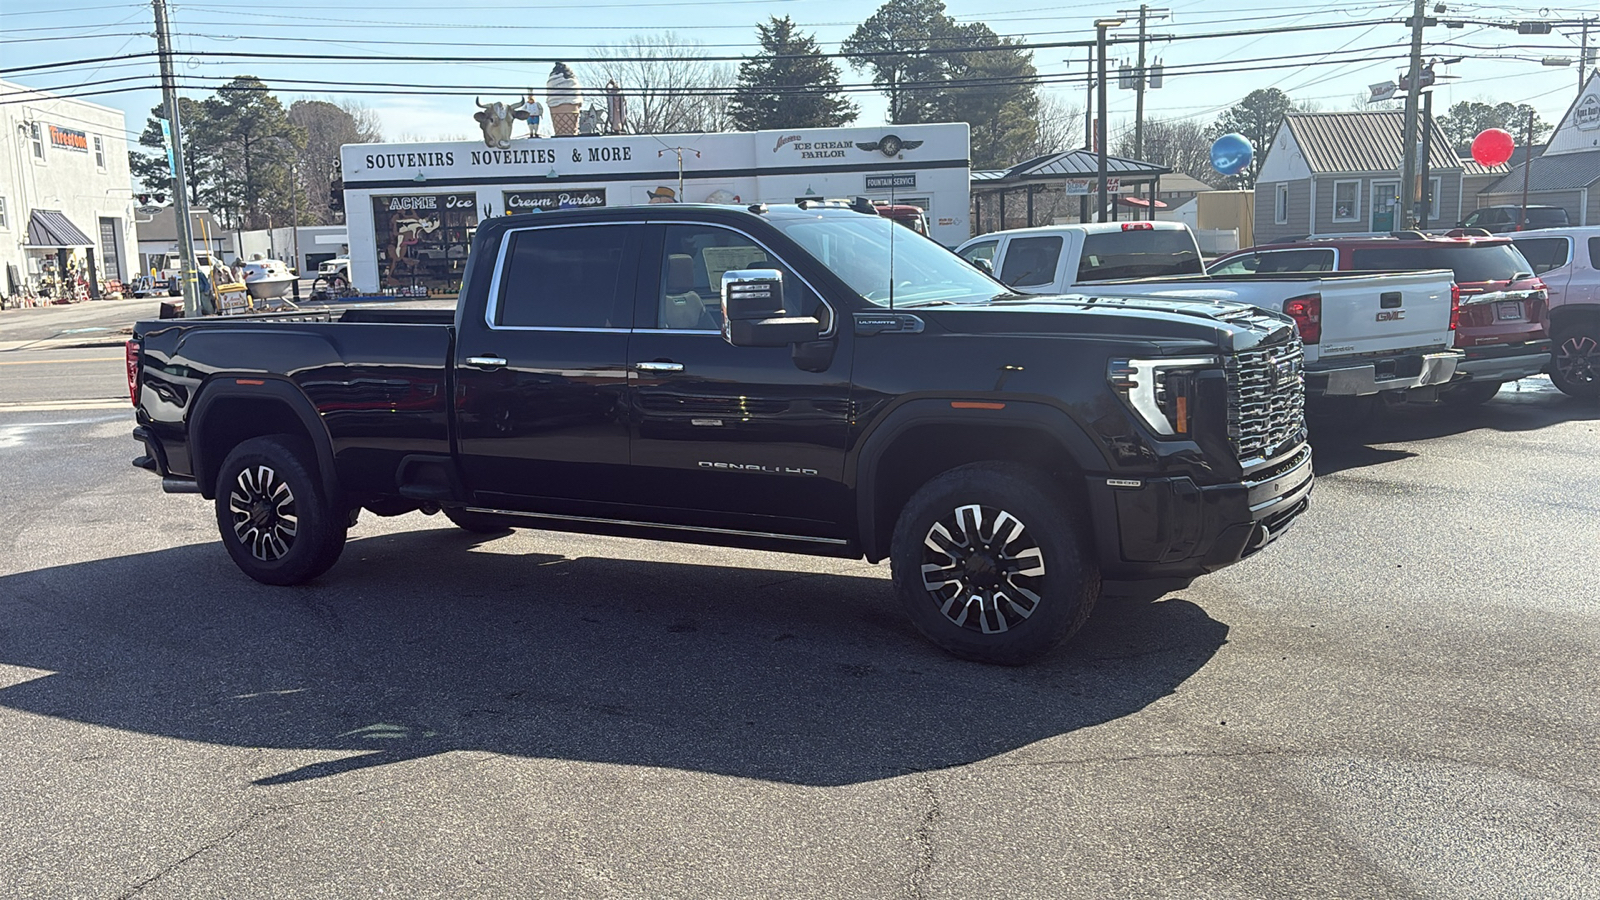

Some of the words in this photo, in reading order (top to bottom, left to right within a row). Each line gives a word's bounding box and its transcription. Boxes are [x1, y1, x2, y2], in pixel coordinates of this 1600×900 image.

[49, 125, 88, 149] Firestone
[794, 142, 812, 151] ICE
[814, 140, 853, 150] CREAM
[366, 151, 455, 169] SOUVENIRS
[471, 148, 556, 166] NOVELTIES
[571, 148, 582, 163] &
[588, 146, 632, 162] MORE
[801, 150, 846, 159] PARLOR
[867, 178, 893, 187] FOUNTAIN
[893, 177, 915, 186] SERVICE
[389, 196, 437, 211] ACME
[446, 195, 474, 209] Ice
[508, 194, 552, 208] Cream
[558, 193, 603, 206] Parlor
[1375, 310, 1405, 322] GMC
[698, 461, 780, 473] DENALI
[785, 467, 818, 476] HD
